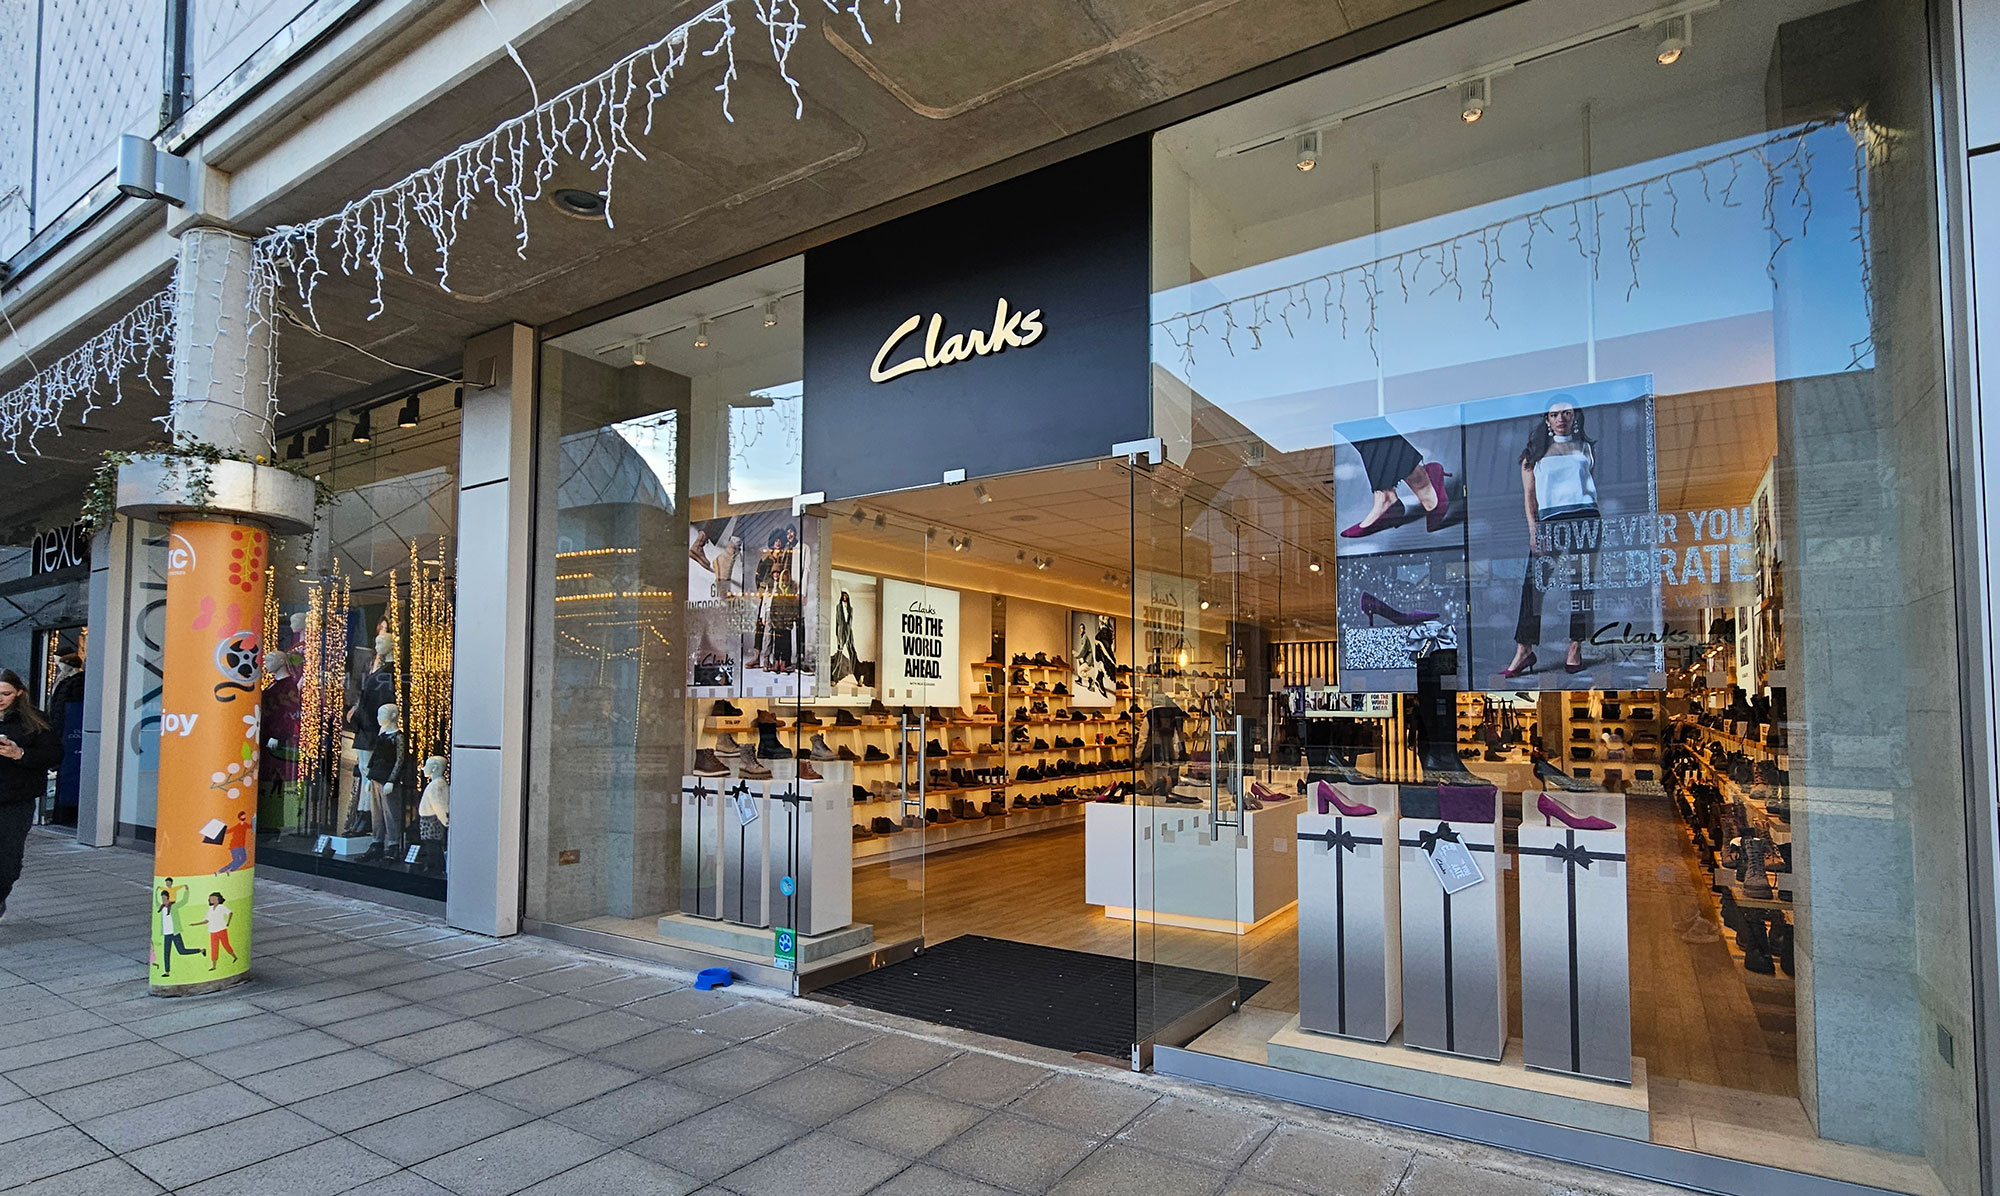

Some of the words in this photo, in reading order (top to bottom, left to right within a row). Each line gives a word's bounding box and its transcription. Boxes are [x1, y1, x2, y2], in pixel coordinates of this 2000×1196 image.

[869, 297, 1044, 383] Clarks
[1535, 512, 1679, 552] HOWEVER
[1687, 506, 1751, 542] YOU
[31, 521, 84, 577] next
[1534, 543, 1754, 593] CELEBRATE
[908, 601, 936, 615] Clarks
[901, 613, 923, 635] FOR
[924, 616, 944, 637] THE
[1590, 621, 1690, 646] Clarks
[902, 635, 942, 658] WORLD
[701, 652, 735, 667] Clarks
[904, 658, 942, 680] AHEAD.
